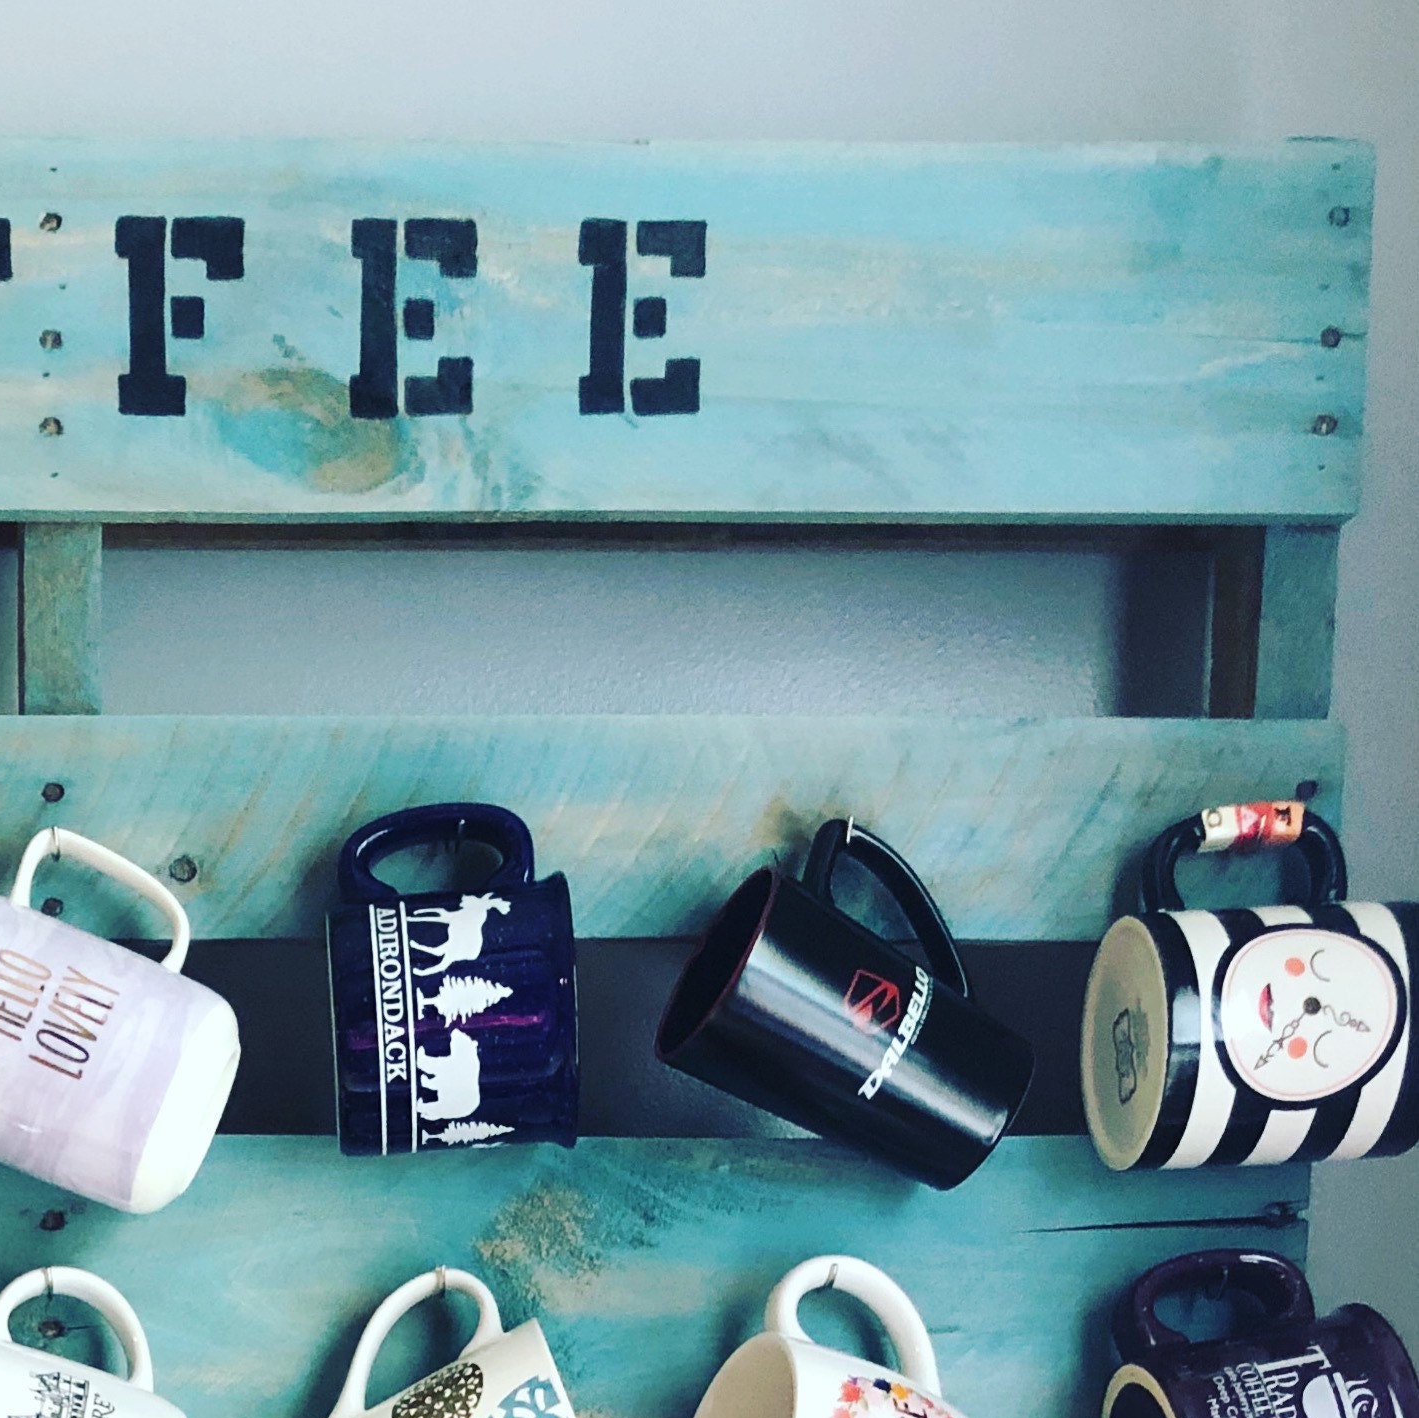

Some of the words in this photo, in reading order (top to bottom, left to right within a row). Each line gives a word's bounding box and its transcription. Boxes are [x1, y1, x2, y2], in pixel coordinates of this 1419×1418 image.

[28, 965, 121, 1080] LOVELY
[376, 907, 407, 1084] ADIRONDACK
[858, 965, 930, 1101] DALBELLO
[1235, 1362, 1275, 1418] COFFEE
